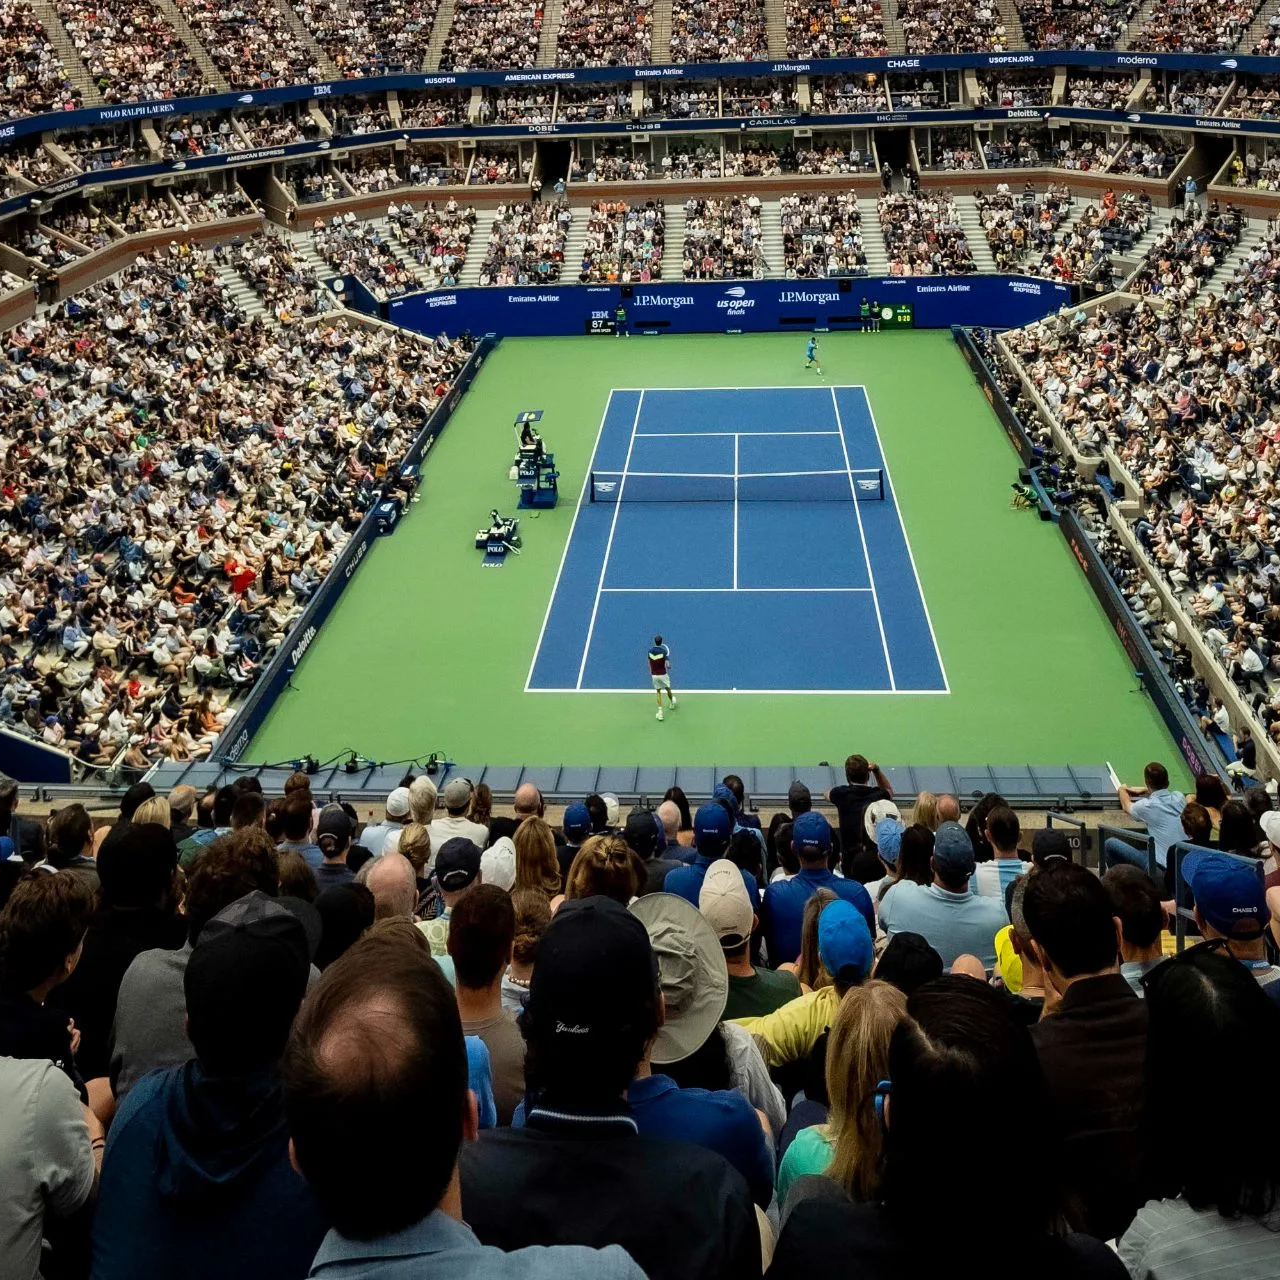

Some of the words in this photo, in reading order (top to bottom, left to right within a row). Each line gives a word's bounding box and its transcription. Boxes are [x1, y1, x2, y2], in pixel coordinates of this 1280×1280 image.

[887, 60, 920, 68] CHASE
[989, 56, 1034, 64] USOPEN.ORG
[1117, 56, 1157, 65] moderna
[772, 64, 810, 73] J.P.Morgan
[543, 72, 575, 80] EXPRESS
[313, 85, 331, 95] IBM
[100, 110, 120, 119] POLO
[122, 108, 145, 118] RALPH
[147, 104, 175, 115] LAUREN
[1007, 110, 1040, 118] Deloitte.
[749, 118, 797, 126] CADILLAC
[1195, 119, 1220, 127] Emirates
[1221, 121, 1241, 129] Airline
[226, 152, 258, 163] AMERICAN
[258, 149, 285, 158] EXPRESS
[917, 285, 945, 293] Emirates
[1008, 281, 1041, 290] AMERICAN
[1013, 286, 1041, 295] EXPRESS
[425, 294, 456, 303] AMERICAN
[508, 295, 538, 303] Emirates
[634, 295, 694, 308] J.P.Morgan
[778, 291, 840, 305] J.P.Morgan
[430, 299, 457, 308] EXPRESS
[728, 299, 754, 309] open
[592, 311, 609, 319] IBM
[727, 308, 745, 316] finals
[592, 320, 603, 328] 87
[345, 541, 367, 578] CHUBB
[291, 626, 318, 666] Deloitte.
[1067, 837, 1081, 849] 10
[555, 1020, 590, 1034] Yankees
